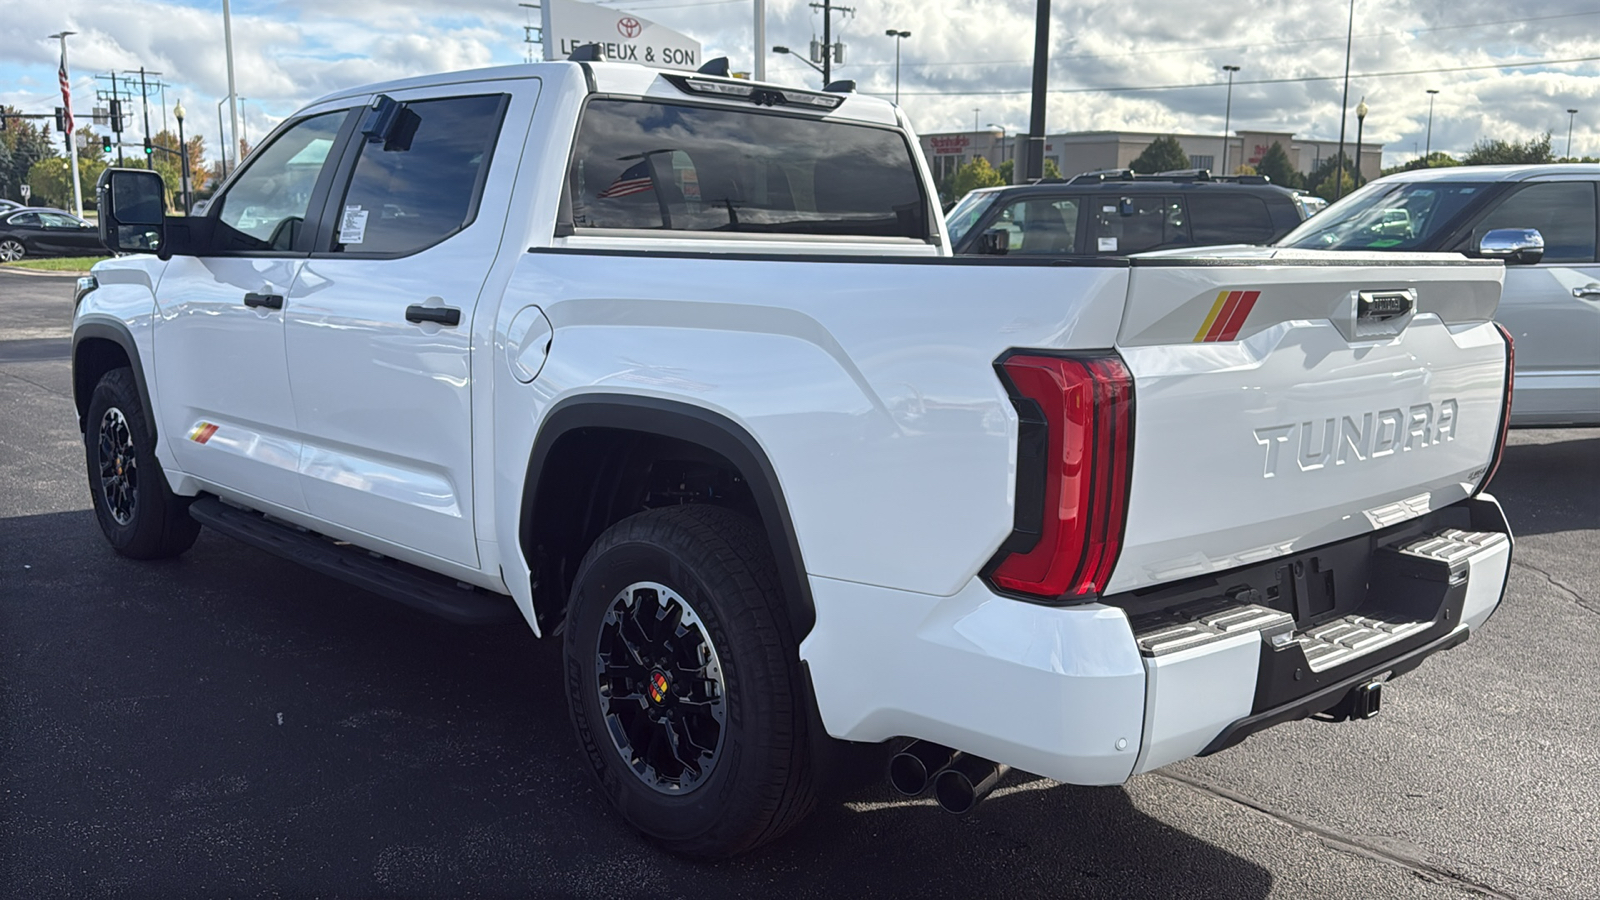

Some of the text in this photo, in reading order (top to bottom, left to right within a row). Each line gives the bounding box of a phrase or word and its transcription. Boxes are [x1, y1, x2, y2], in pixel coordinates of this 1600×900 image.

[645, 46, 655, 62] &
[663, 47, 695, 66] SON
[1253, 398, 1459, 478] TUNDRA
